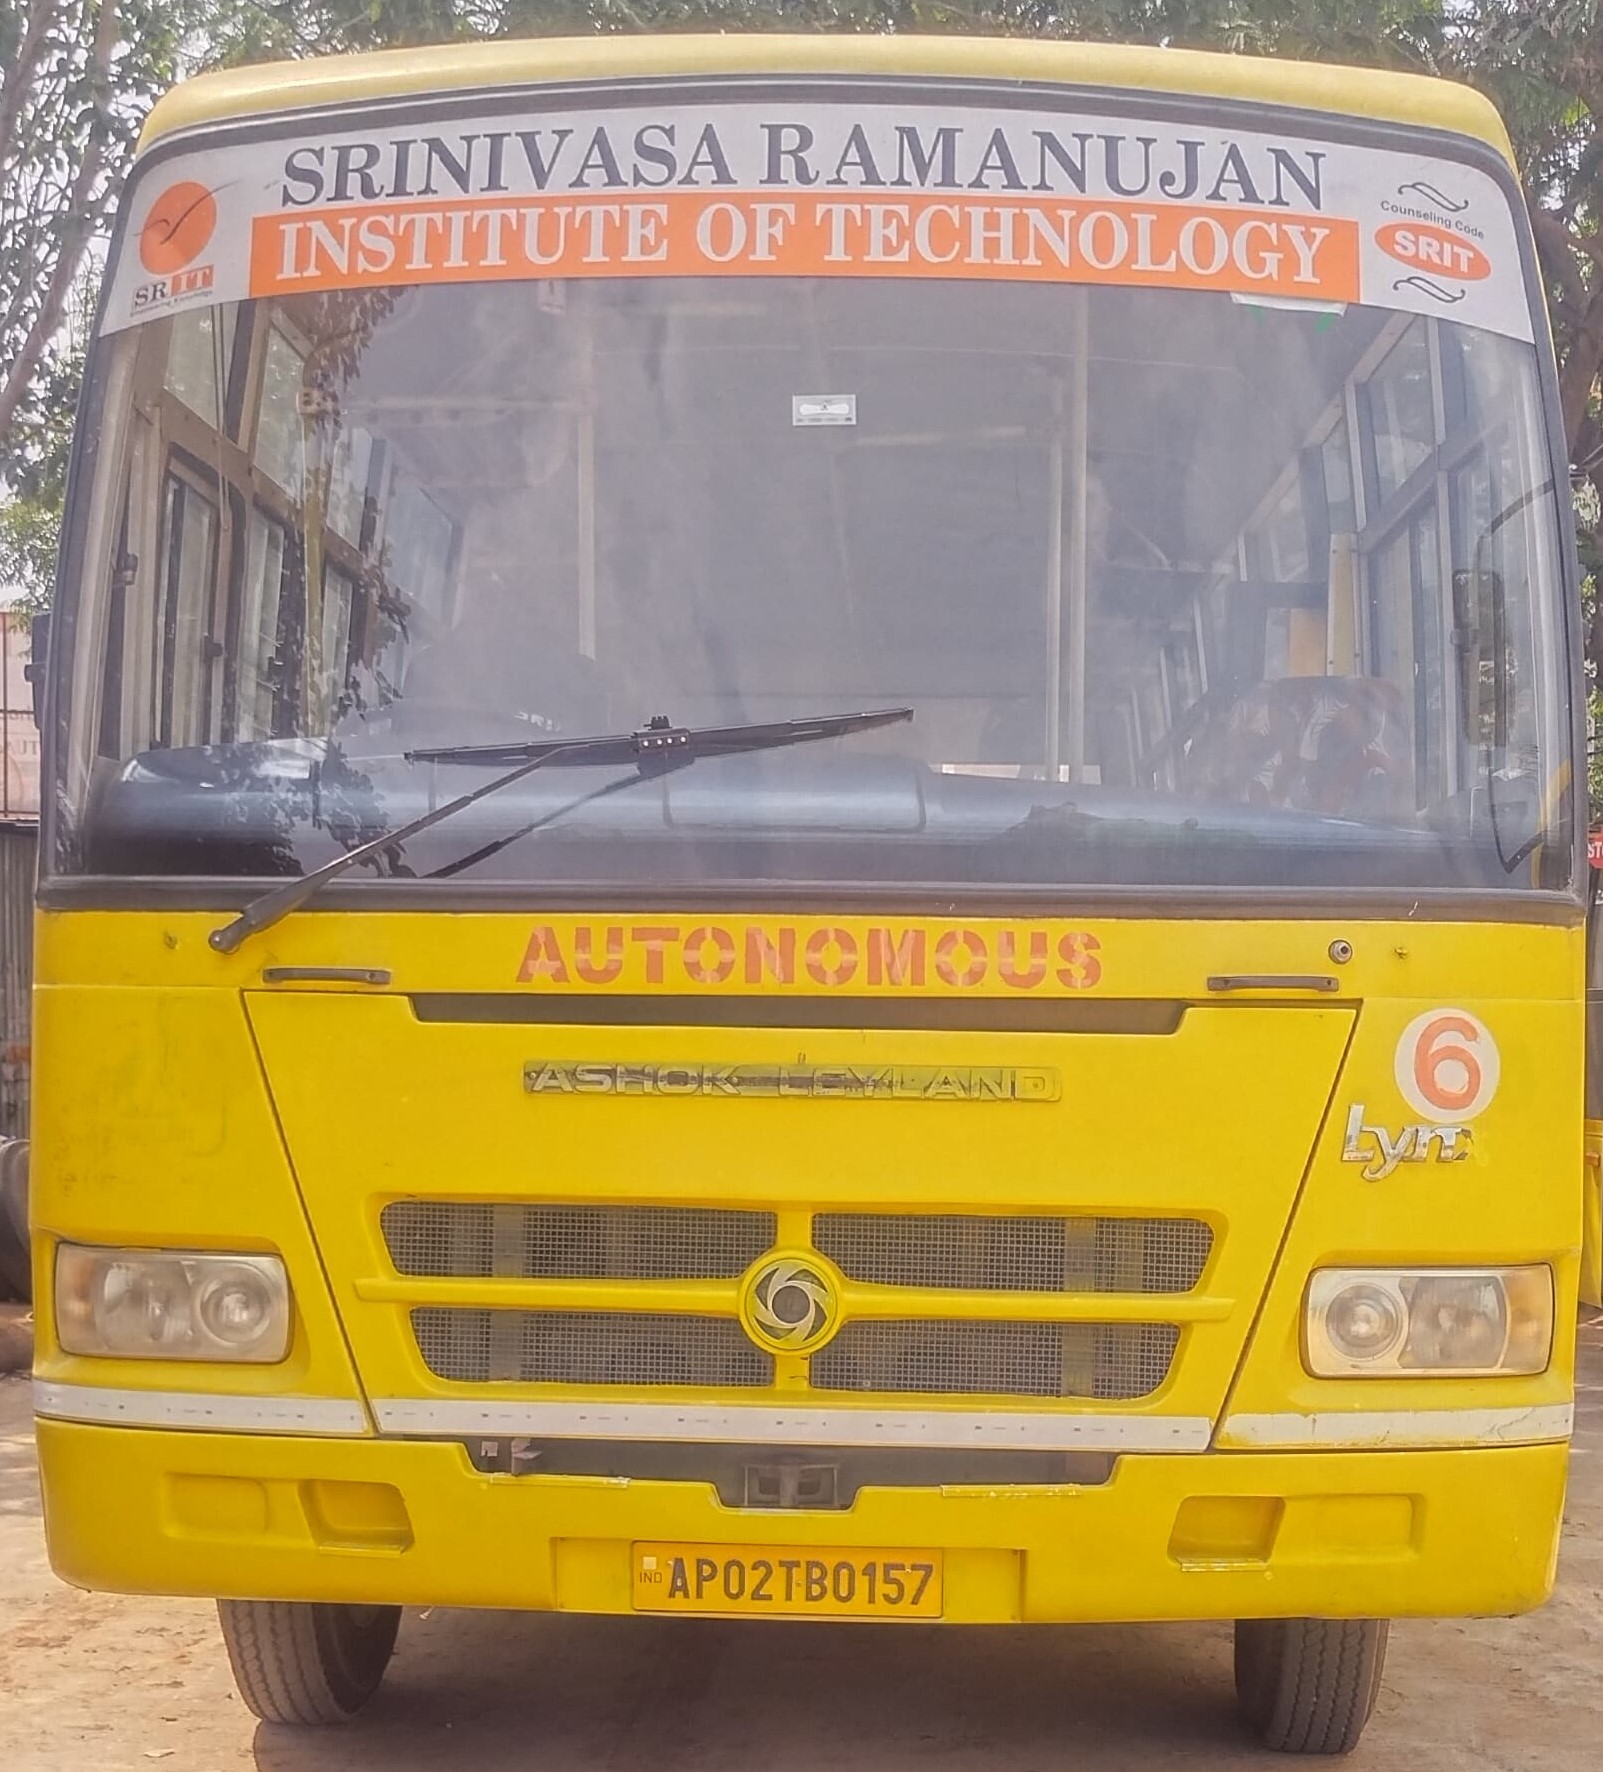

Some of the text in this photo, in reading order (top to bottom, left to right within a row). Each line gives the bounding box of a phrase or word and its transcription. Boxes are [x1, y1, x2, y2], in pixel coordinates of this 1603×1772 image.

[282, 122, 1327, 211] SRINIVASA RAMANUJAN
[1380, 199, 1485, 240] Counseling Code
[275, 203, 1331, 285] INSTITUTE OF TECHNOLOGY
[1393, 229, 1474, 274] SRIT
[1587, 841, 1603, 859] ST
[515, 927, 1101, 990] AUTONOMOUS
[532, 1062, 1056, 1101] ASHOK LEYLAND
[1413, 1016, 1481, 1111] 6
[639, 1572, 662, 1584] IND
[668, 1556, 933, 1606] AP02TB0157
